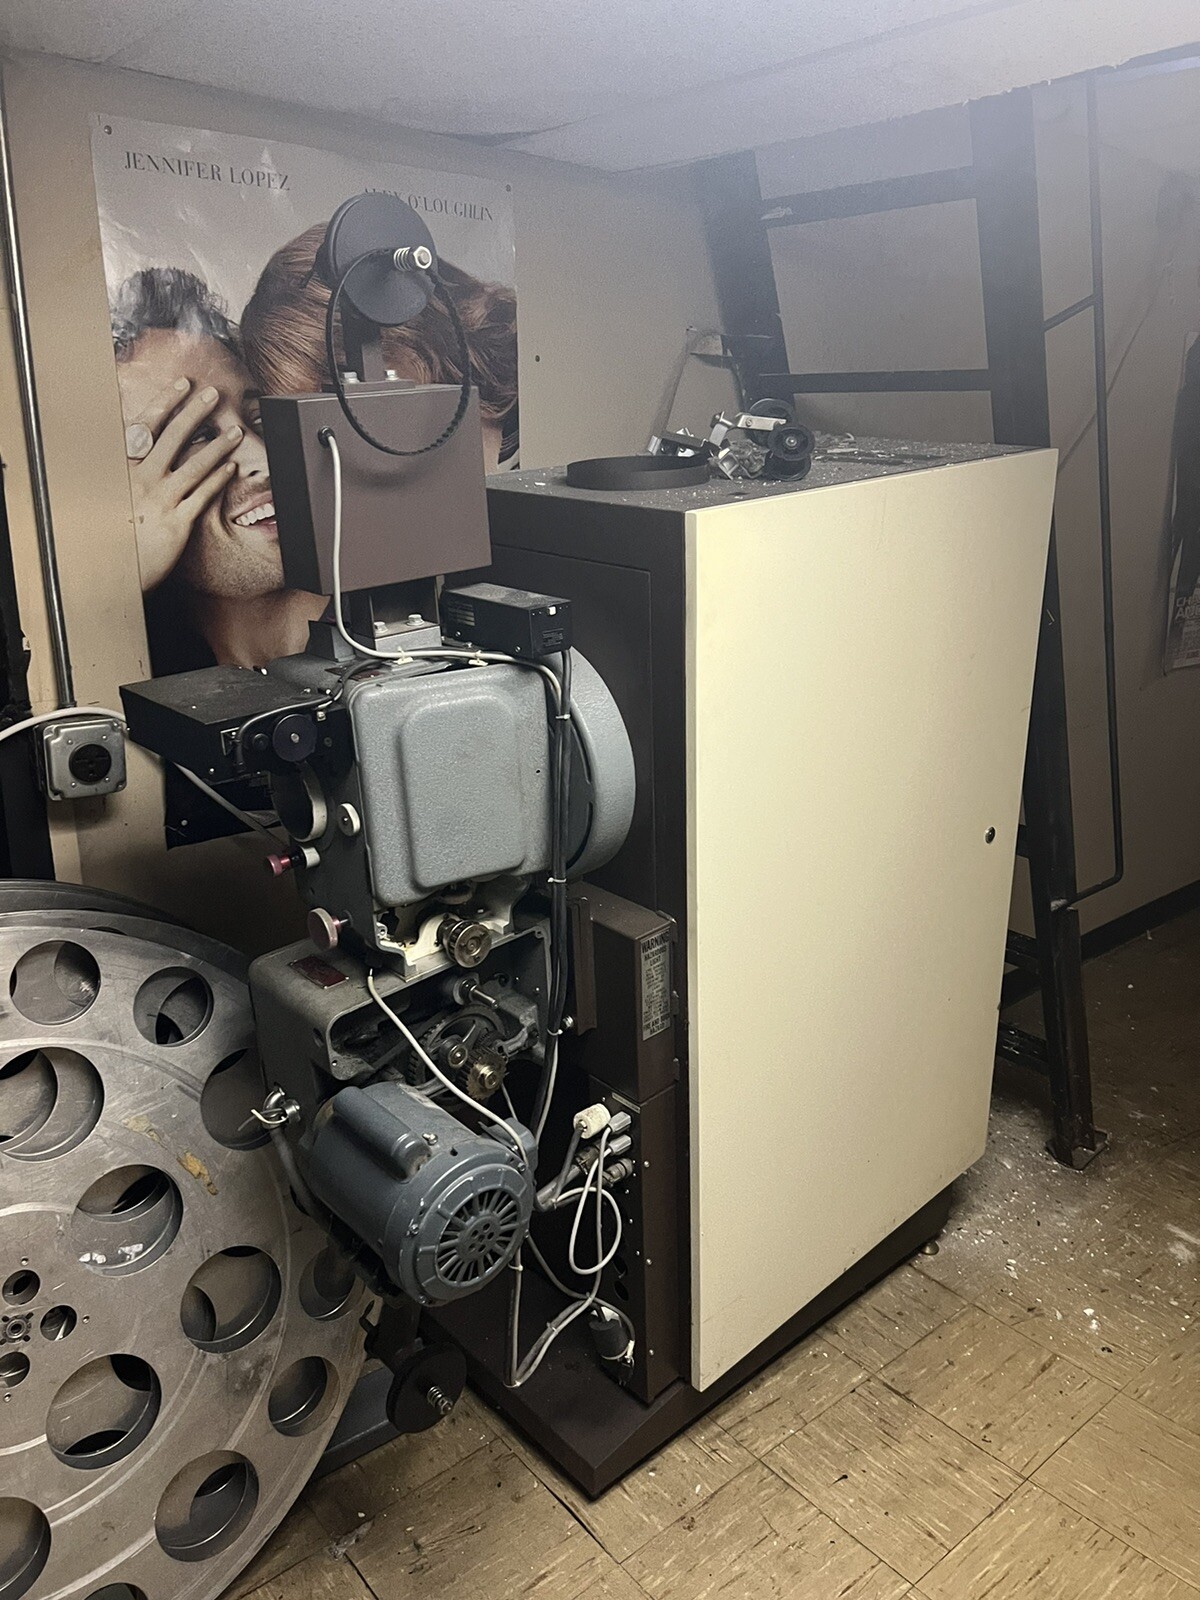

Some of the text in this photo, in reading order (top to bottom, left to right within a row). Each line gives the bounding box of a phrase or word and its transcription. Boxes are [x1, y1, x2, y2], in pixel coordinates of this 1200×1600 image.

[124, 150, 291, 191] JENNIFER LOPEZ
[408, 194, 494, 221] O'LOUGHLIN
